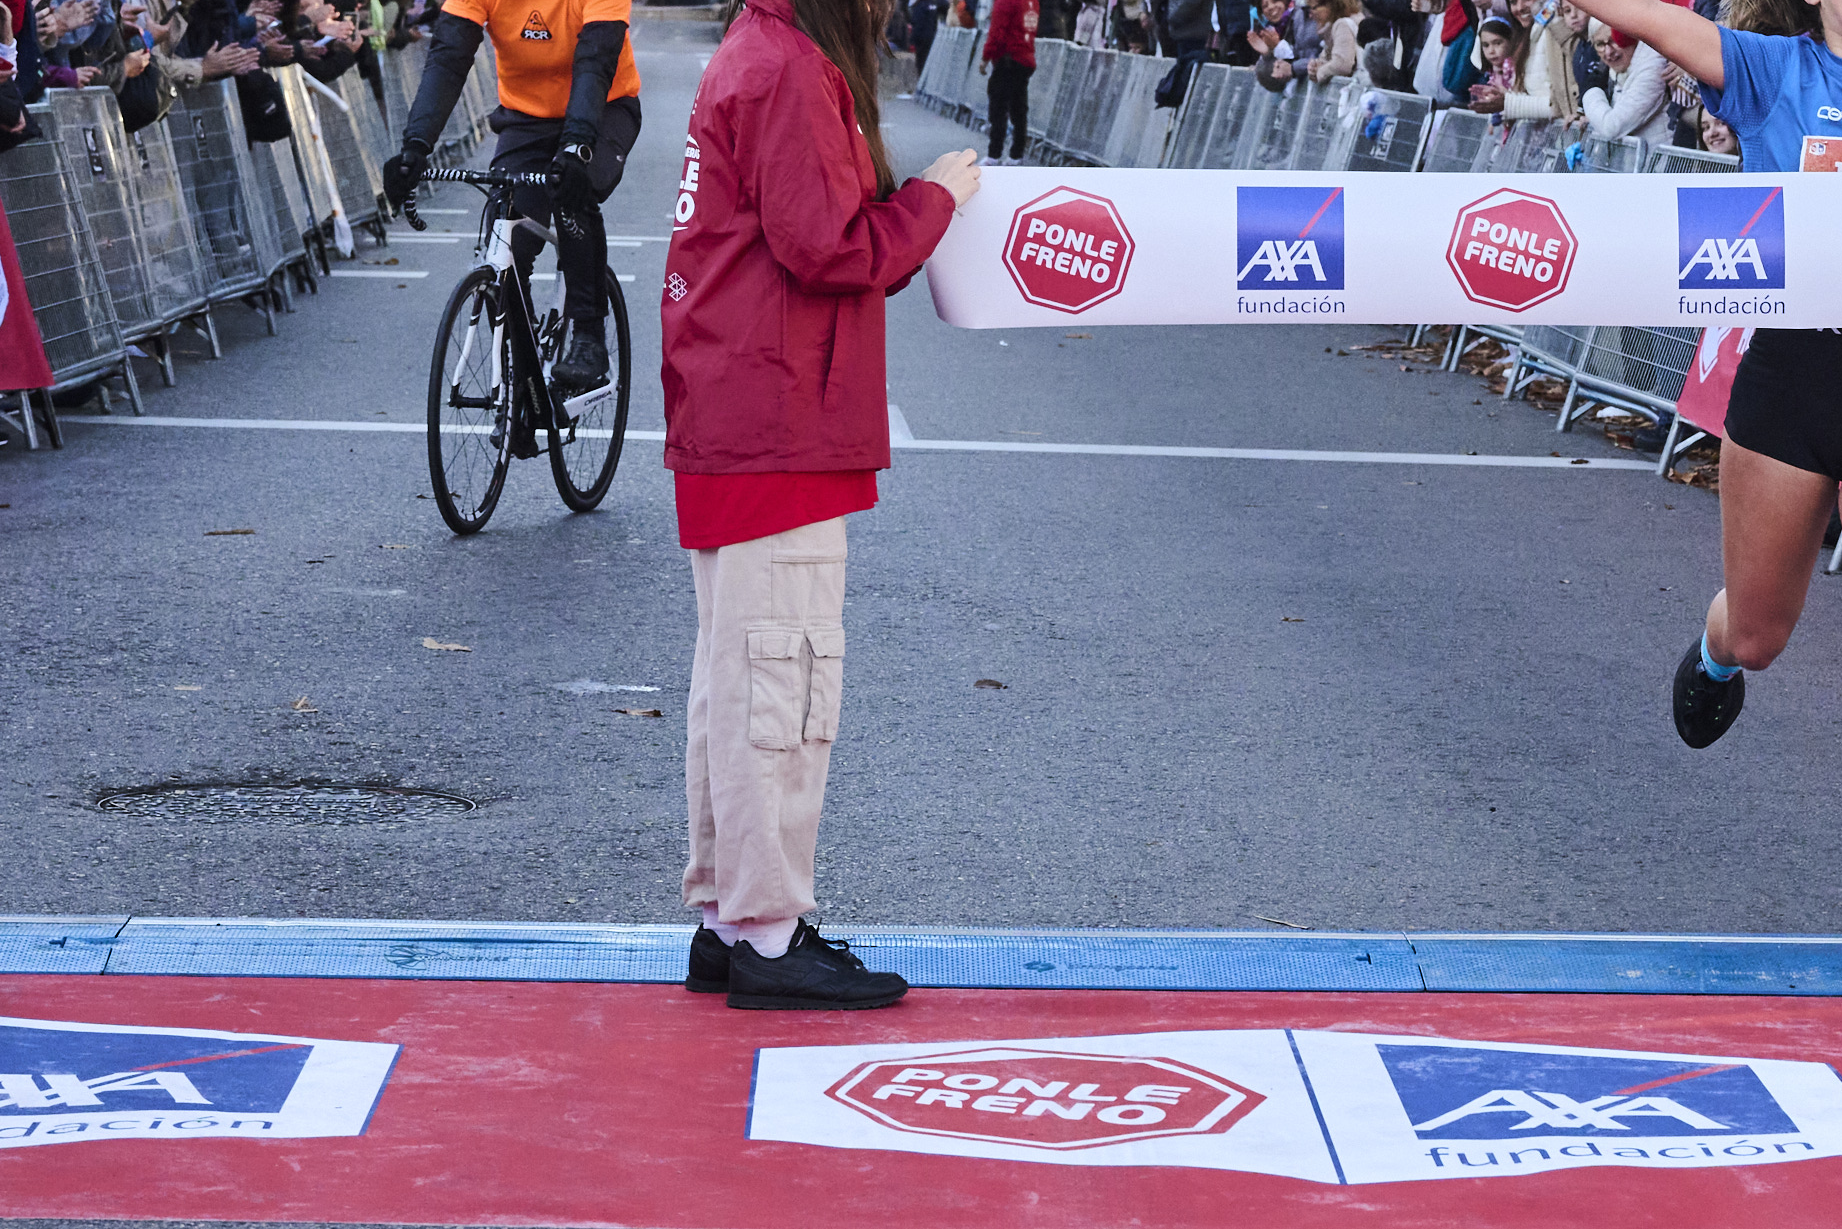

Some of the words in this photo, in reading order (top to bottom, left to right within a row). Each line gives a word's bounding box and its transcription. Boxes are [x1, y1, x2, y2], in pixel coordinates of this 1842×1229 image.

[1026, 217, 1119, 263] PONLE
[1236, 239, 1327, 282] AXA
[1469, 217, 1562, 262] PONLE
[1678, 238, 1768, 281] AXA
[1018, 240, 1112, 285] FRENO
[1462, 240, 1554, 285] FRENO
[1236, 295, 1346, 315] fundación
[1677, 295, 1786, 316] fundación
[872, 1084, 1169, 1126] FRENO
[892, 1066, 1191, 1107] PONLE
[0, 1116, 274, 1138] dación
[1413, 1089, 1731, 1132] AXA
[1423, 1138, 1816, 1169] fundación
